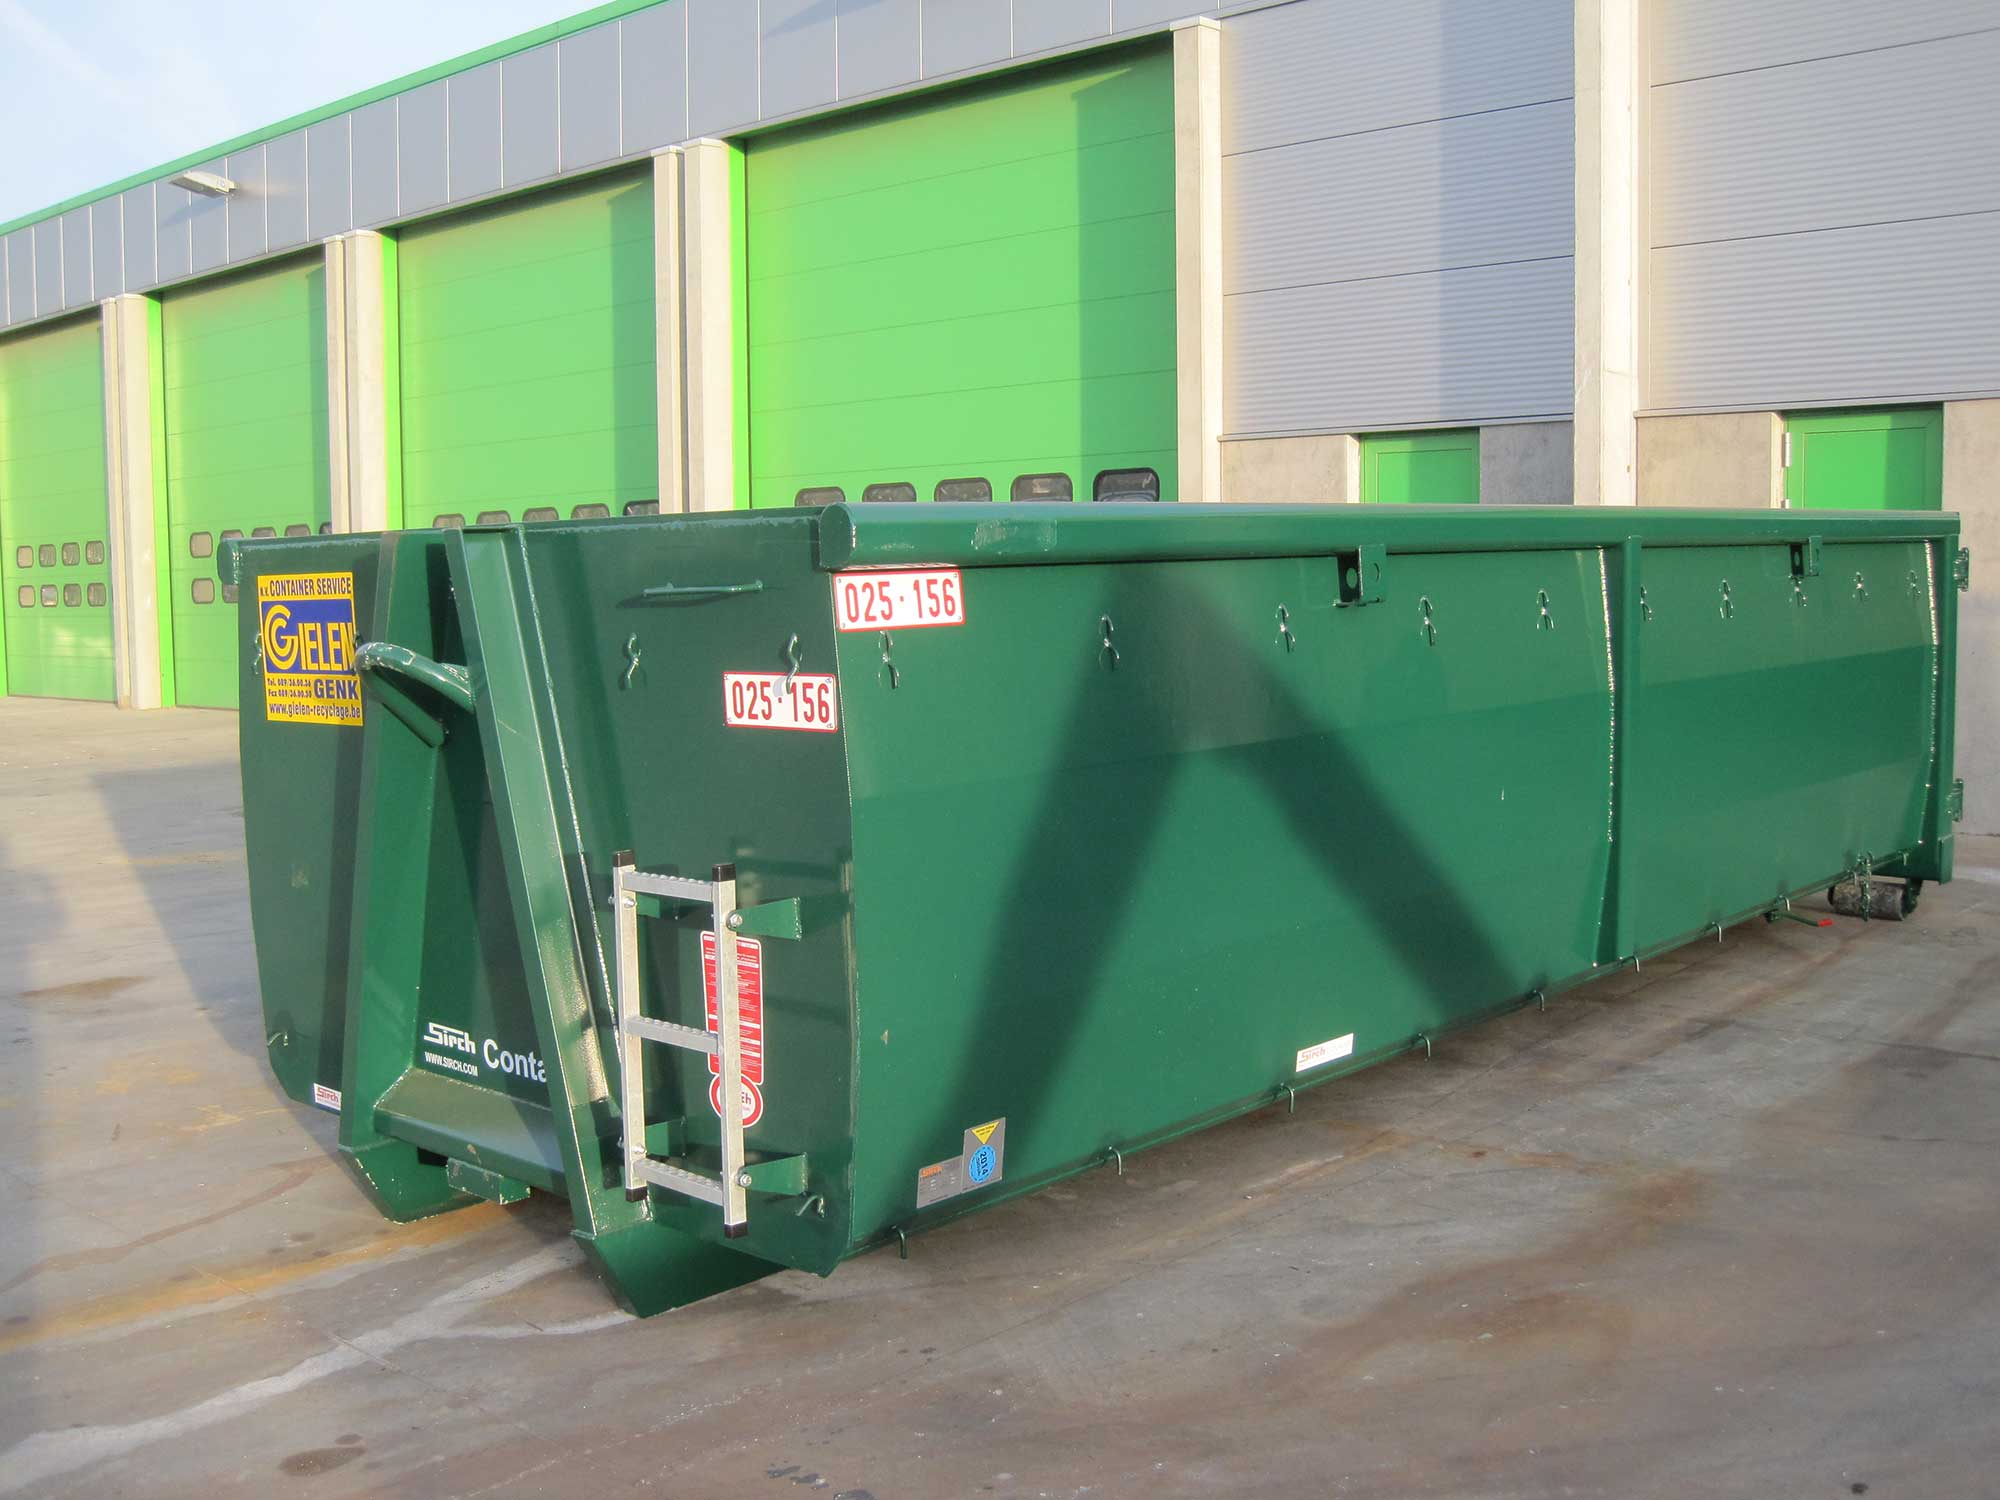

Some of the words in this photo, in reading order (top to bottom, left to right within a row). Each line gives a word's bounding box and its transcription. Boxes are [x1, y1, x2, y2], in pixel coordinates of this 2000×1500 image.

[270, 579, 314, 596] CONTAINER
[317, 577, 351, 595] SERVICE
[264, 604, 354, 670] GIELEN
[268, 689, 277, 697] Fax
[313, 679, 359, 700] GENK
[269, 702, 361, 721] www.gielen-recyclage.be
[423, 1022, 476, 1055] Sirch
[424, 1051, 478, 1077] WWW.SIRCH.COM
[316, 1087, 339, 1102] Sirch
